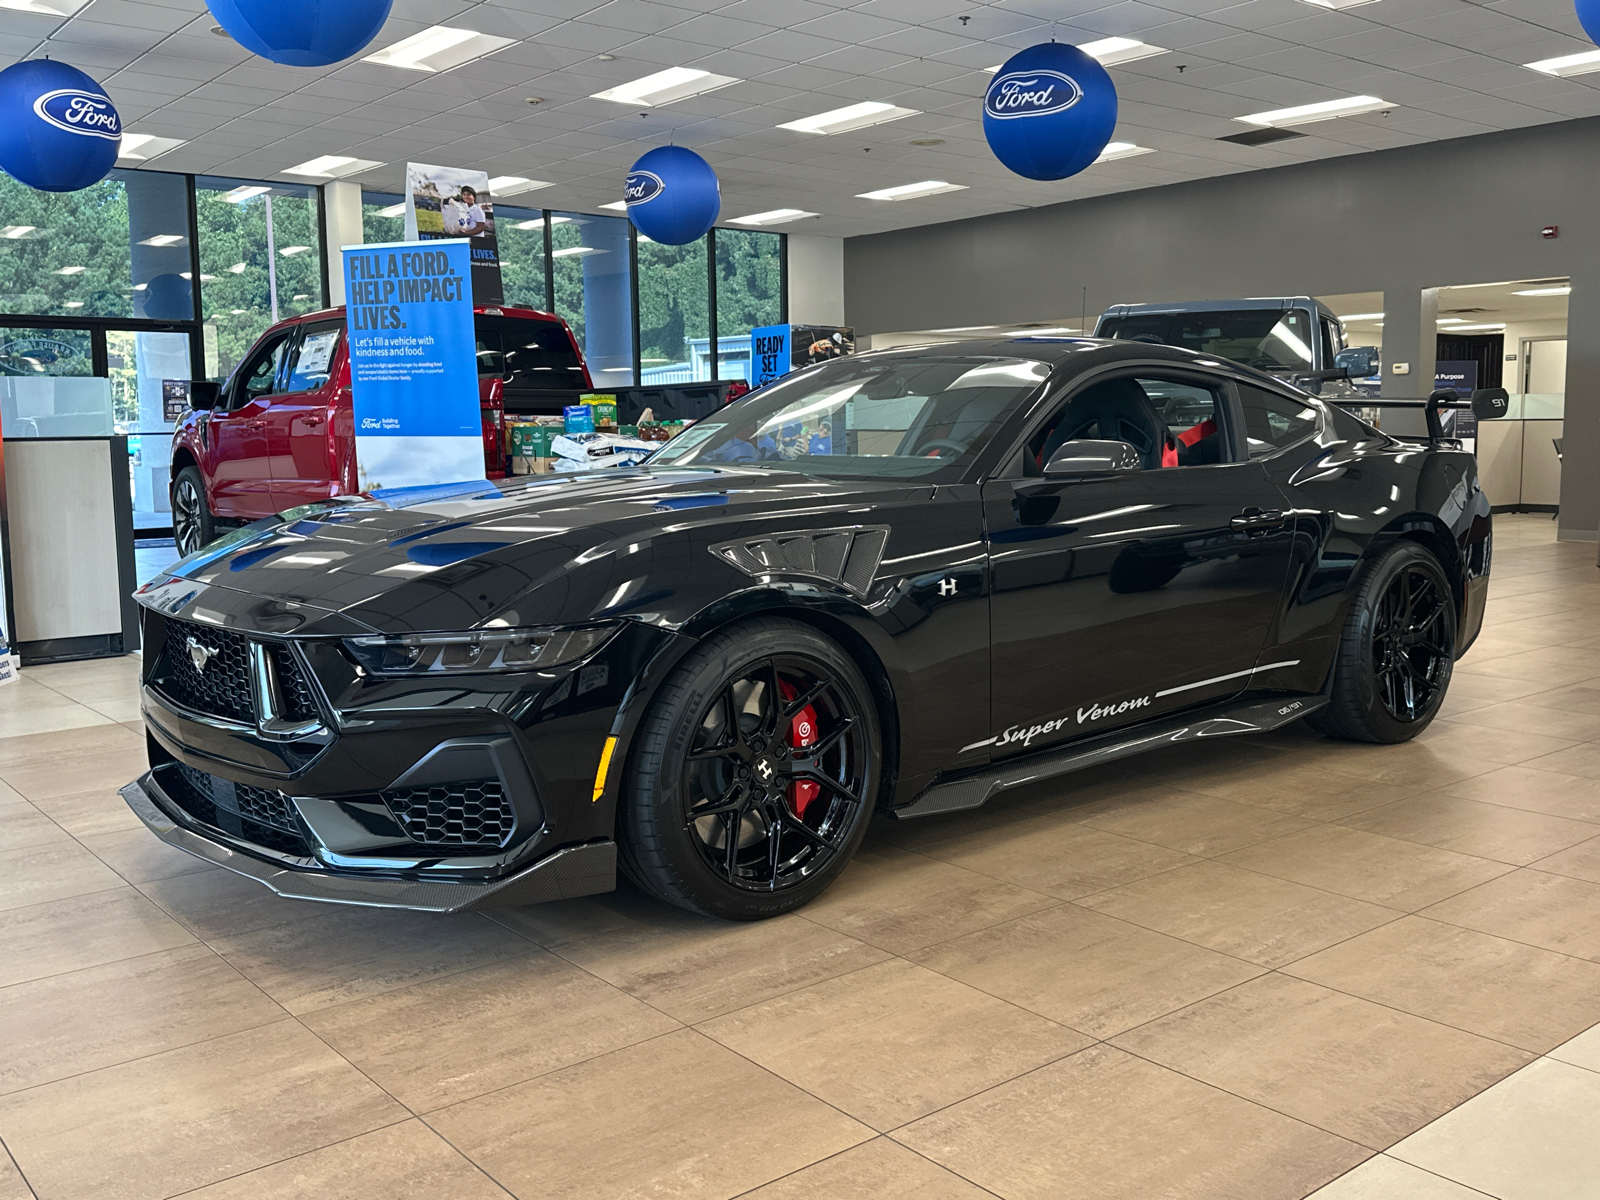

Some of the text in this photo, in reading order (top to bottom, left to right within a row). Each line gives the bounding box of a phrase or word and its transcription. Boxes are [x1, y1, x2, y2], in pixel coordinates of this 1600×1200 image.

[996, 79, 1054, 110] Ford
[65, 98, 117, 130] Ford
[350, 251, 454, 280] FILL A FORD.
[352, 277, 463, 305] HELP IMPACT
[354, 305, 406, 330] LIVES.
[355, 338, 373, 347] Let's
[374, 337, 383, 346] fill
[389, 336, 416, 346] vehicle
[418, 335, 434, 345] with
[756, 335, 784, 355] READY
[356, 346, 425, 357] kindness and food.
[762, 355, 777, 372] SET
[1492, 398, 1505, 407] 91
[361, 418, 381, 429] Ford
[937, 578, 958, 596] H
[1278, 701, 1303, 715] 06/91
[668, 689, 704, 751] PIRELLI
[996, 696, 1150, 746] Super Venom
